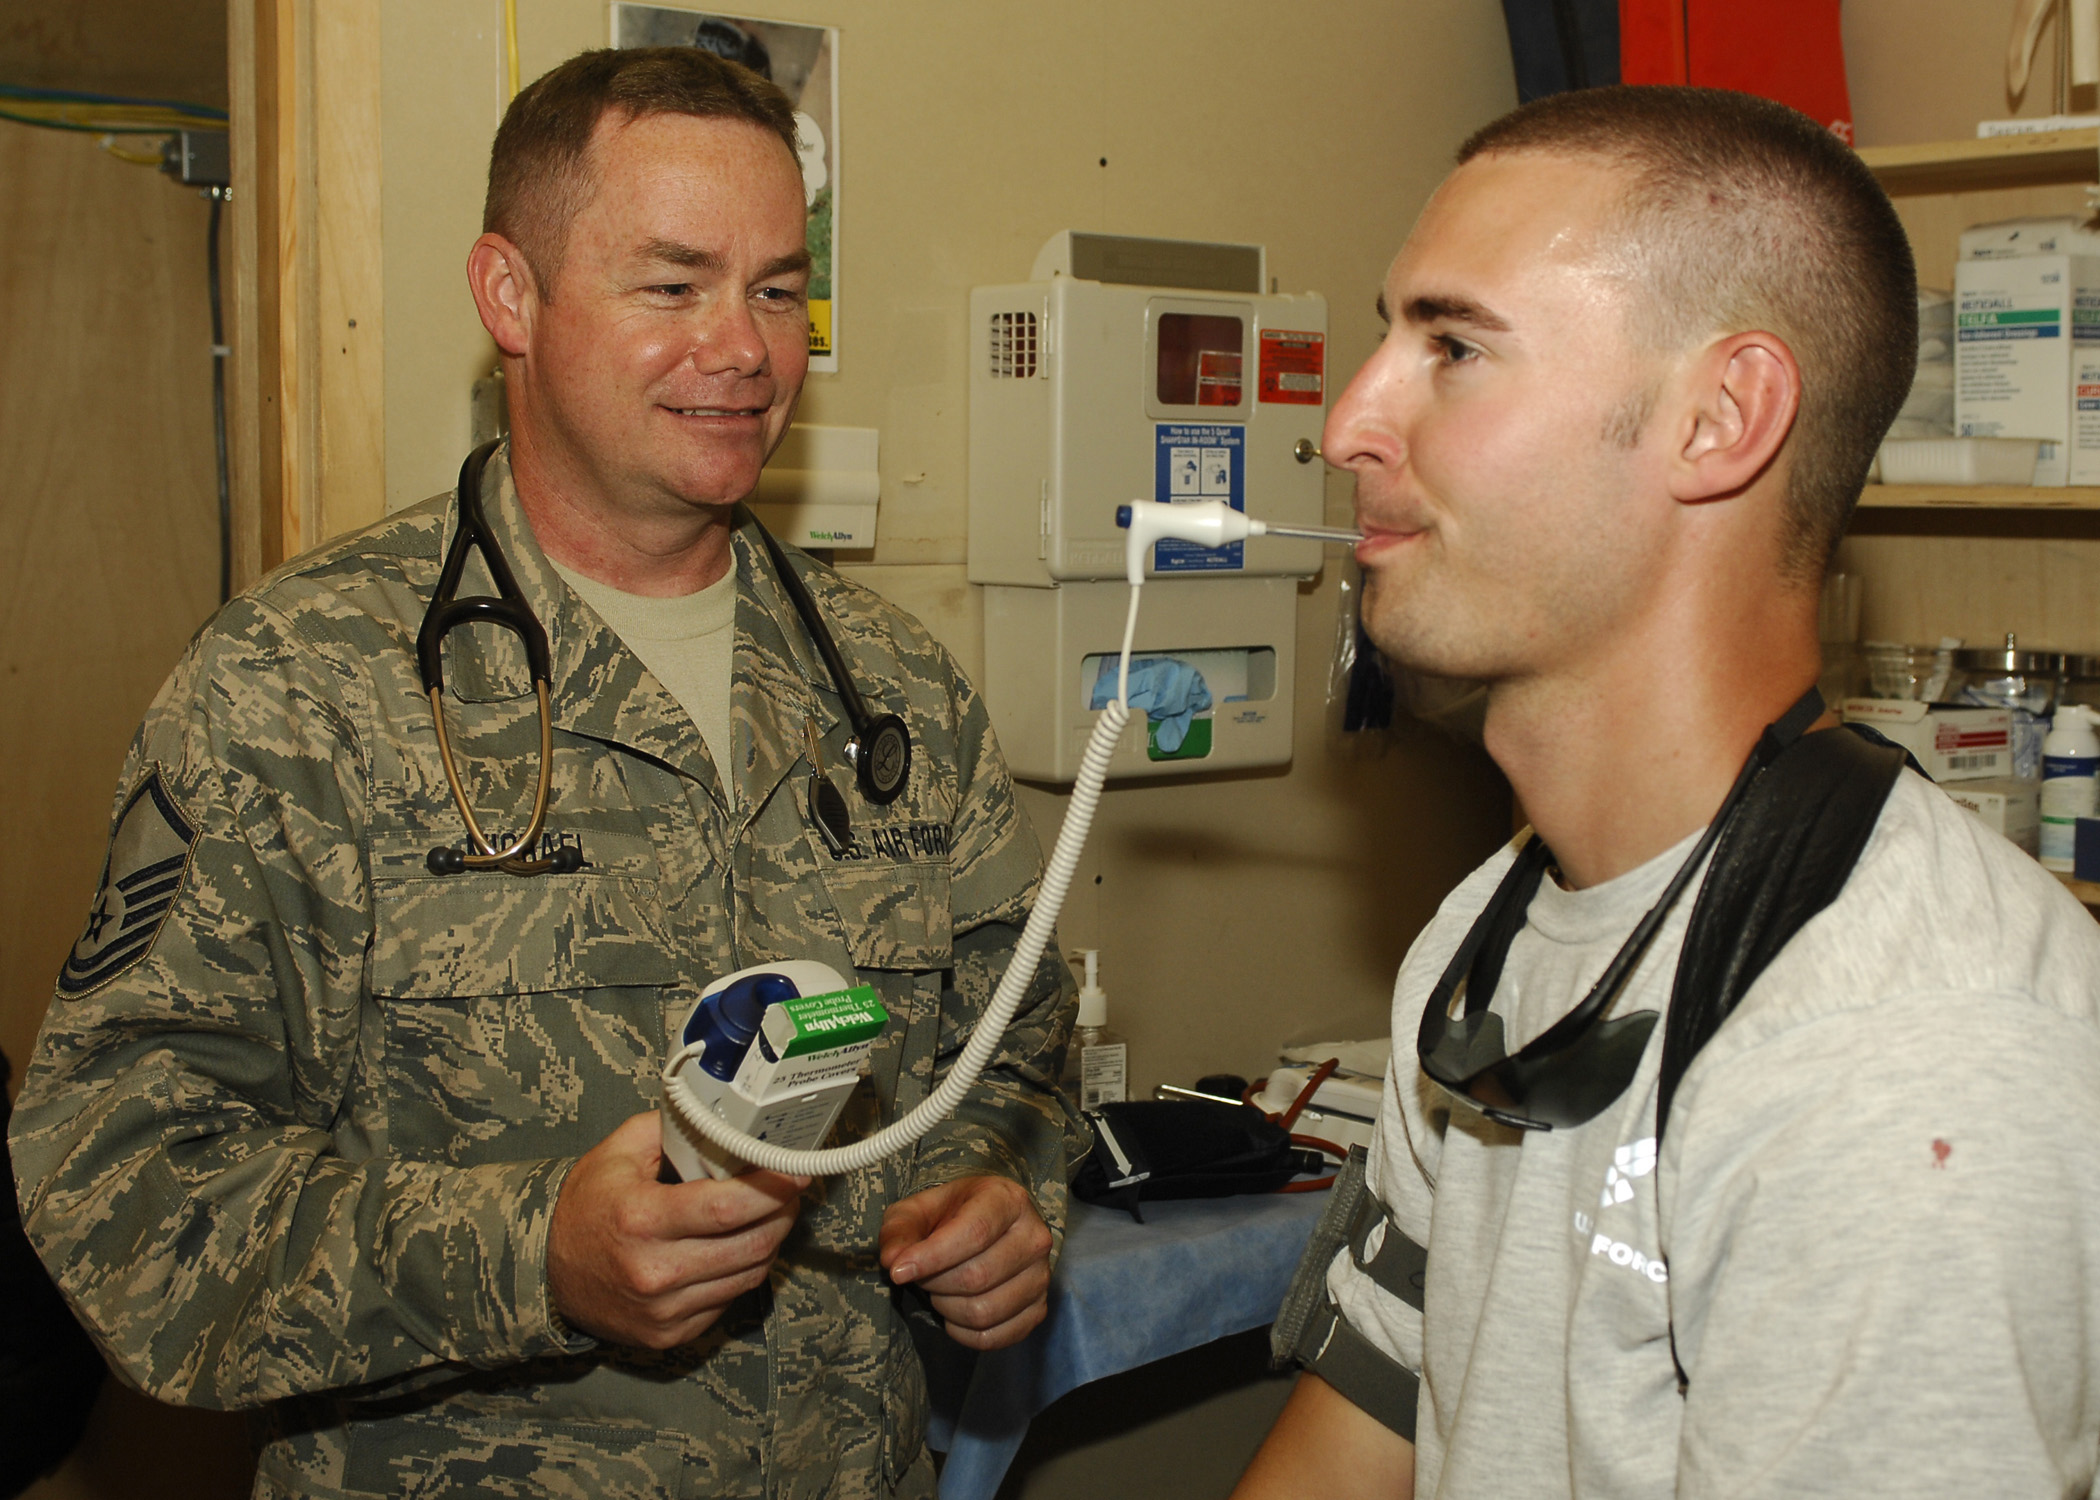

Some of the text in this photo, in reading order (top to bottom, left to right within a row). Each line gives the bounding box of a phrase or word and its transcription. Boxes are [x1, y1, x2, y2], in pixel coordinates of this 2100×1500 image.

[872, 827, 909, 858] AIR
[789, 995, 852, 1012] Probe Covers
[798, 1000, 876, 1020] 25 Thermometer
[804, 1011, 874, 1031] WelchAllyn
[788, 1067, 857, 1088] Probe Covers
[791, 1058, 861, 1080] Thermometer
